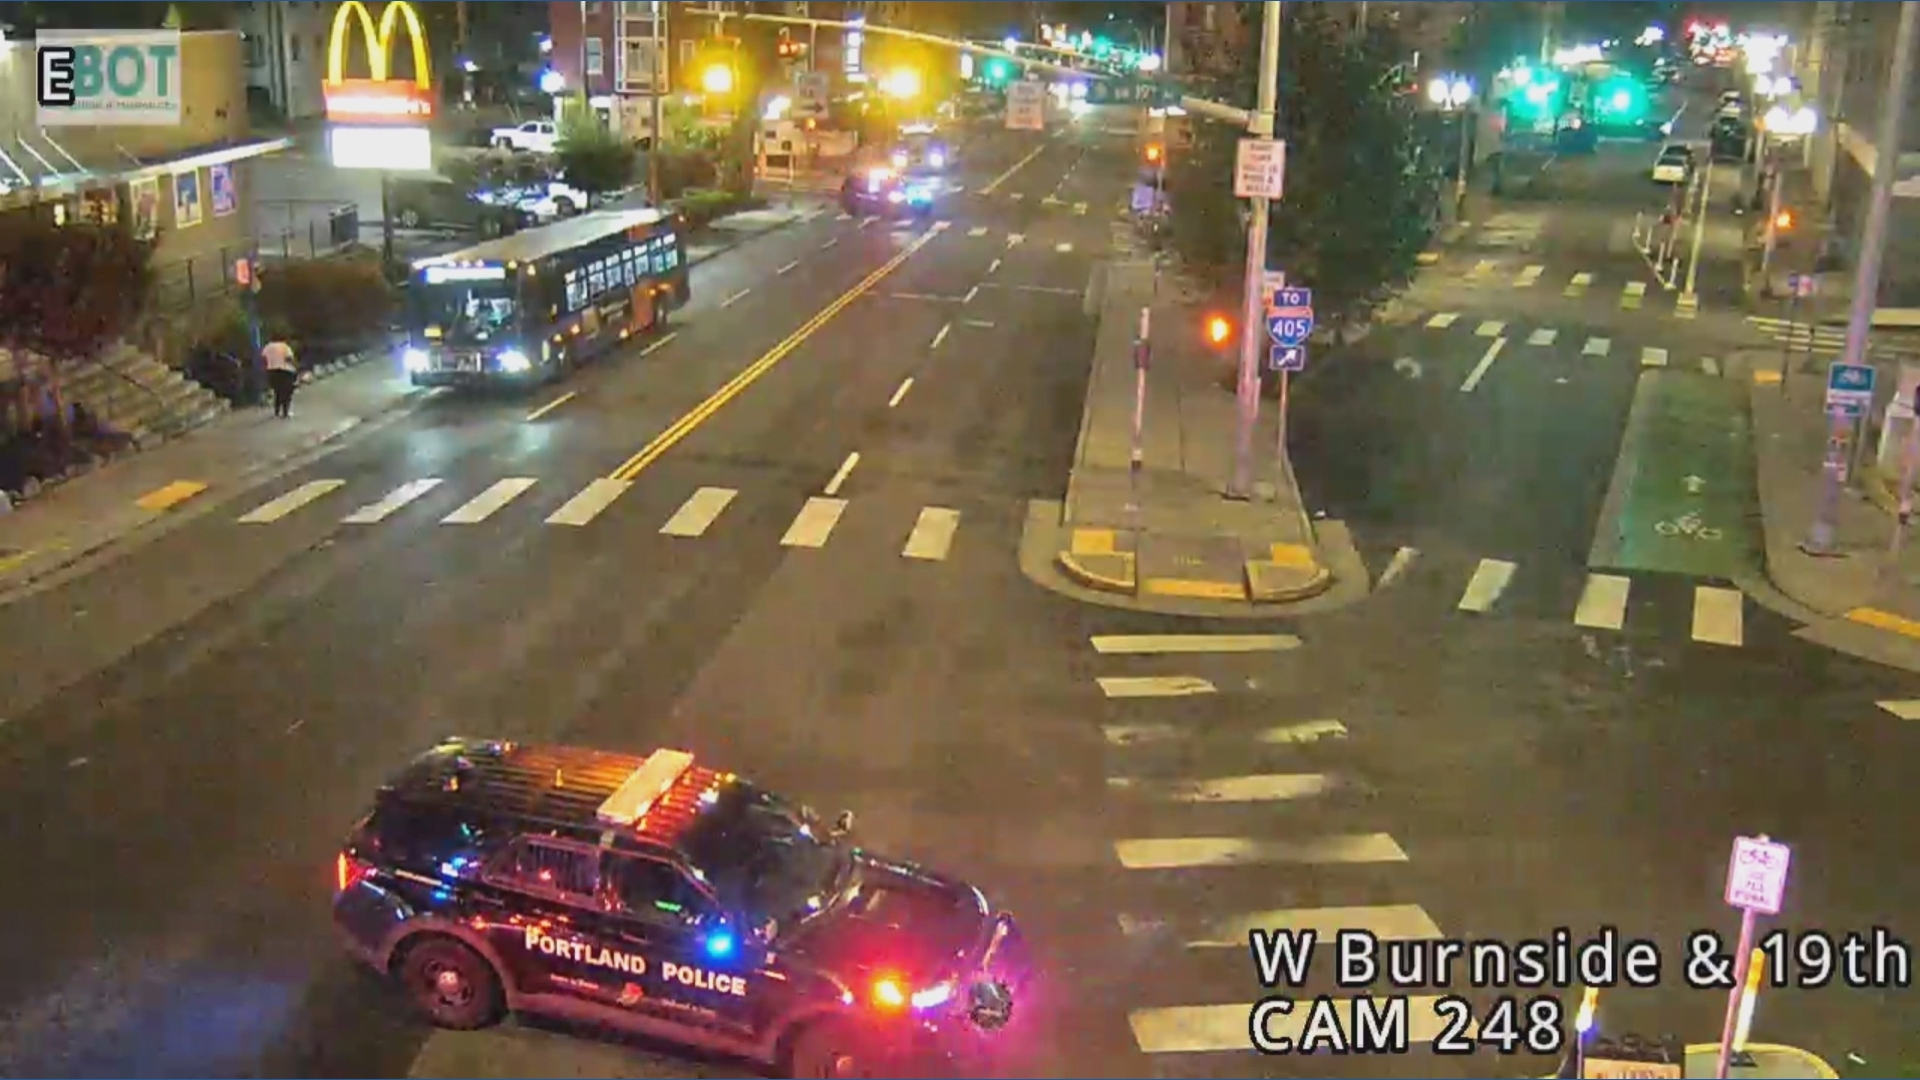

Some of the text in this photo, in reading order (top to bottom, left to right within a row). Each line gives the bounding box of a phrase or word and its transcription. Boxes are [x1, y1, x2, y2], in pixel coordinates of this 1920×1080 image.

[1281, 292, 1301, 305] TO
[1272, 319, 1307, 338] 405
[524, 924, 748, 997] PORTLAND POLICE
